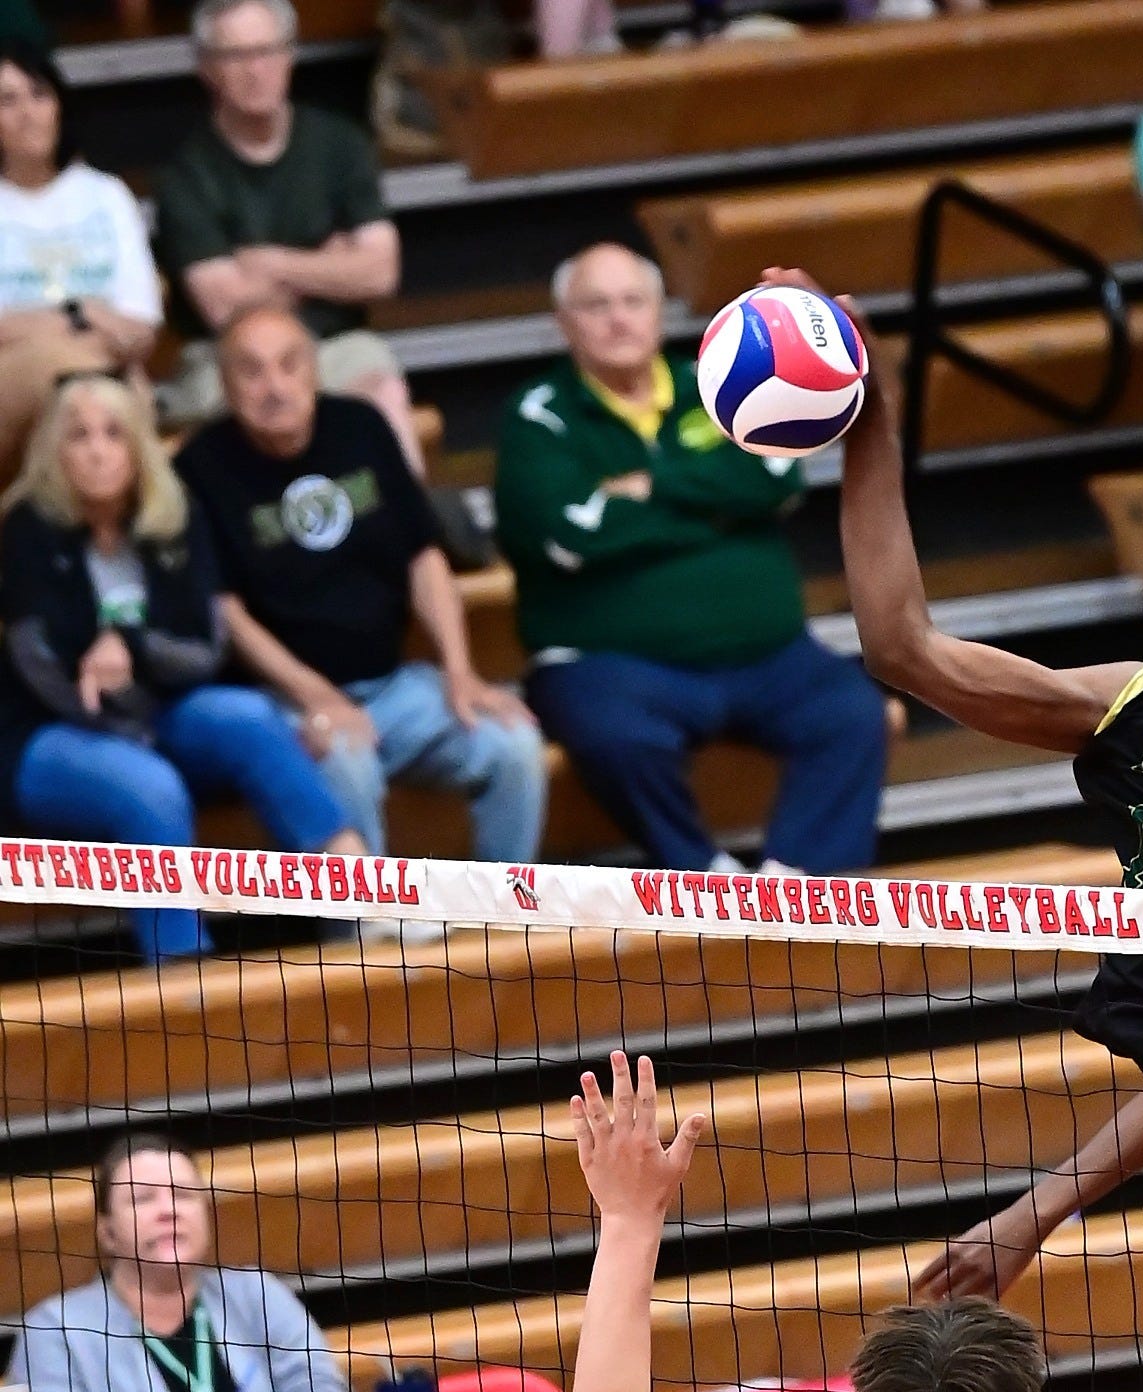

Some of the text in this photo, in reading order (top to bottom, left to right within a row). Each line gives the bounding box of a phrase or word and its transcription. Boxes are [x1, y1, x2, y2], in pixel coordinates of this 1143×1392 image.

[0, 843, 420, 904] TTENBERG VOLLEYBALL
[631, 871, 1140, 940] WITTENBERG VOLLEYBALL
